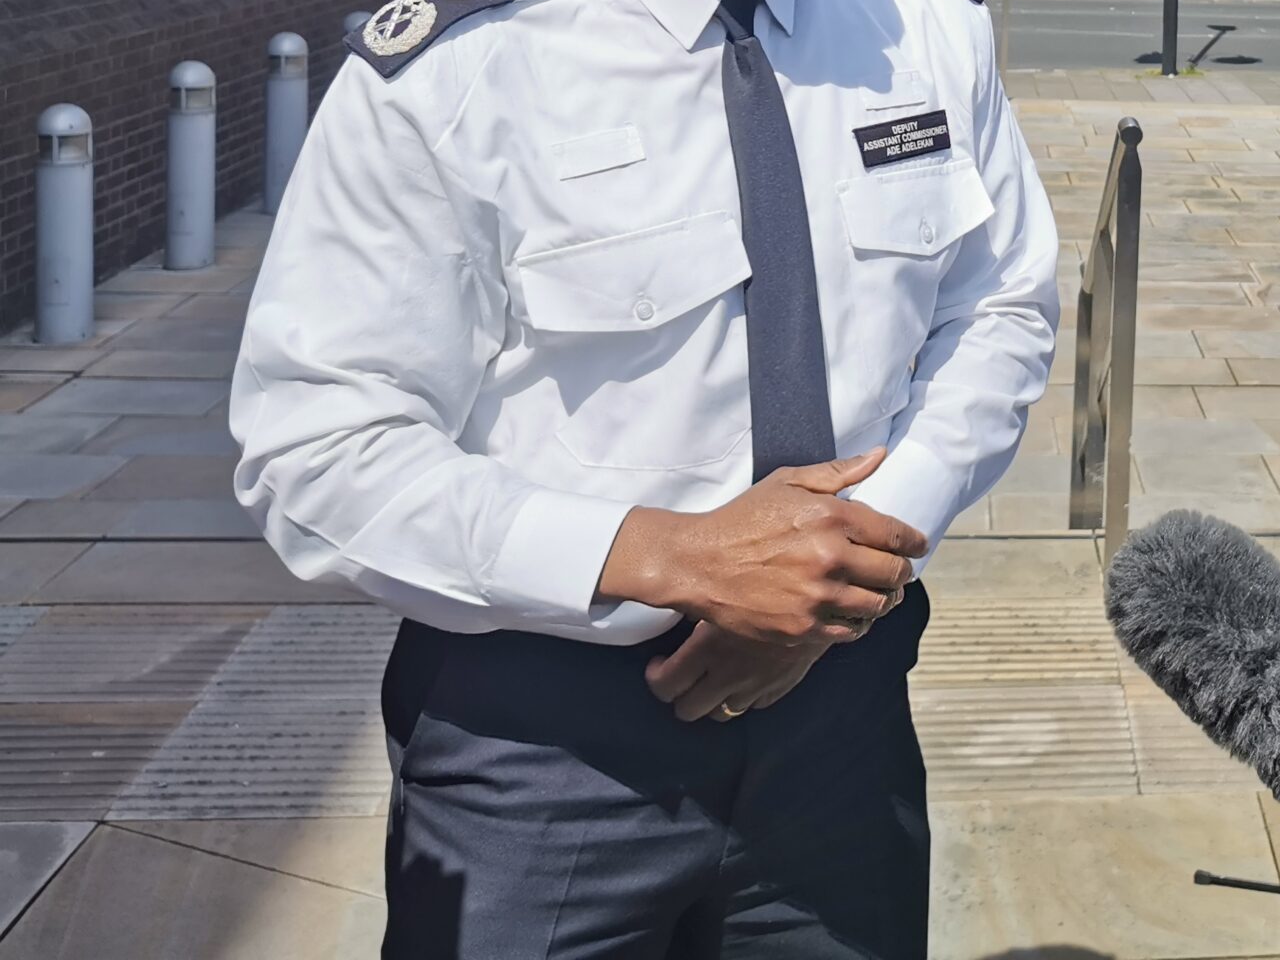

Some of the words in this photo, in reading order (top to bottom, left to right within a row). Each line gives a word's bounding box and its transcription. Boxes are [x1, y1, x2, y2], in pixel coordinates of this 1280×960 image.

[891, 121, 918, 134] DEPUTY
[863, 135, 901, 151] ASSISTANT
[901, 125, 948, 142] COMMISSIONER
[886, 144, 901, 156] ADE
[902, 138, 934, 153] ADELEKAN
